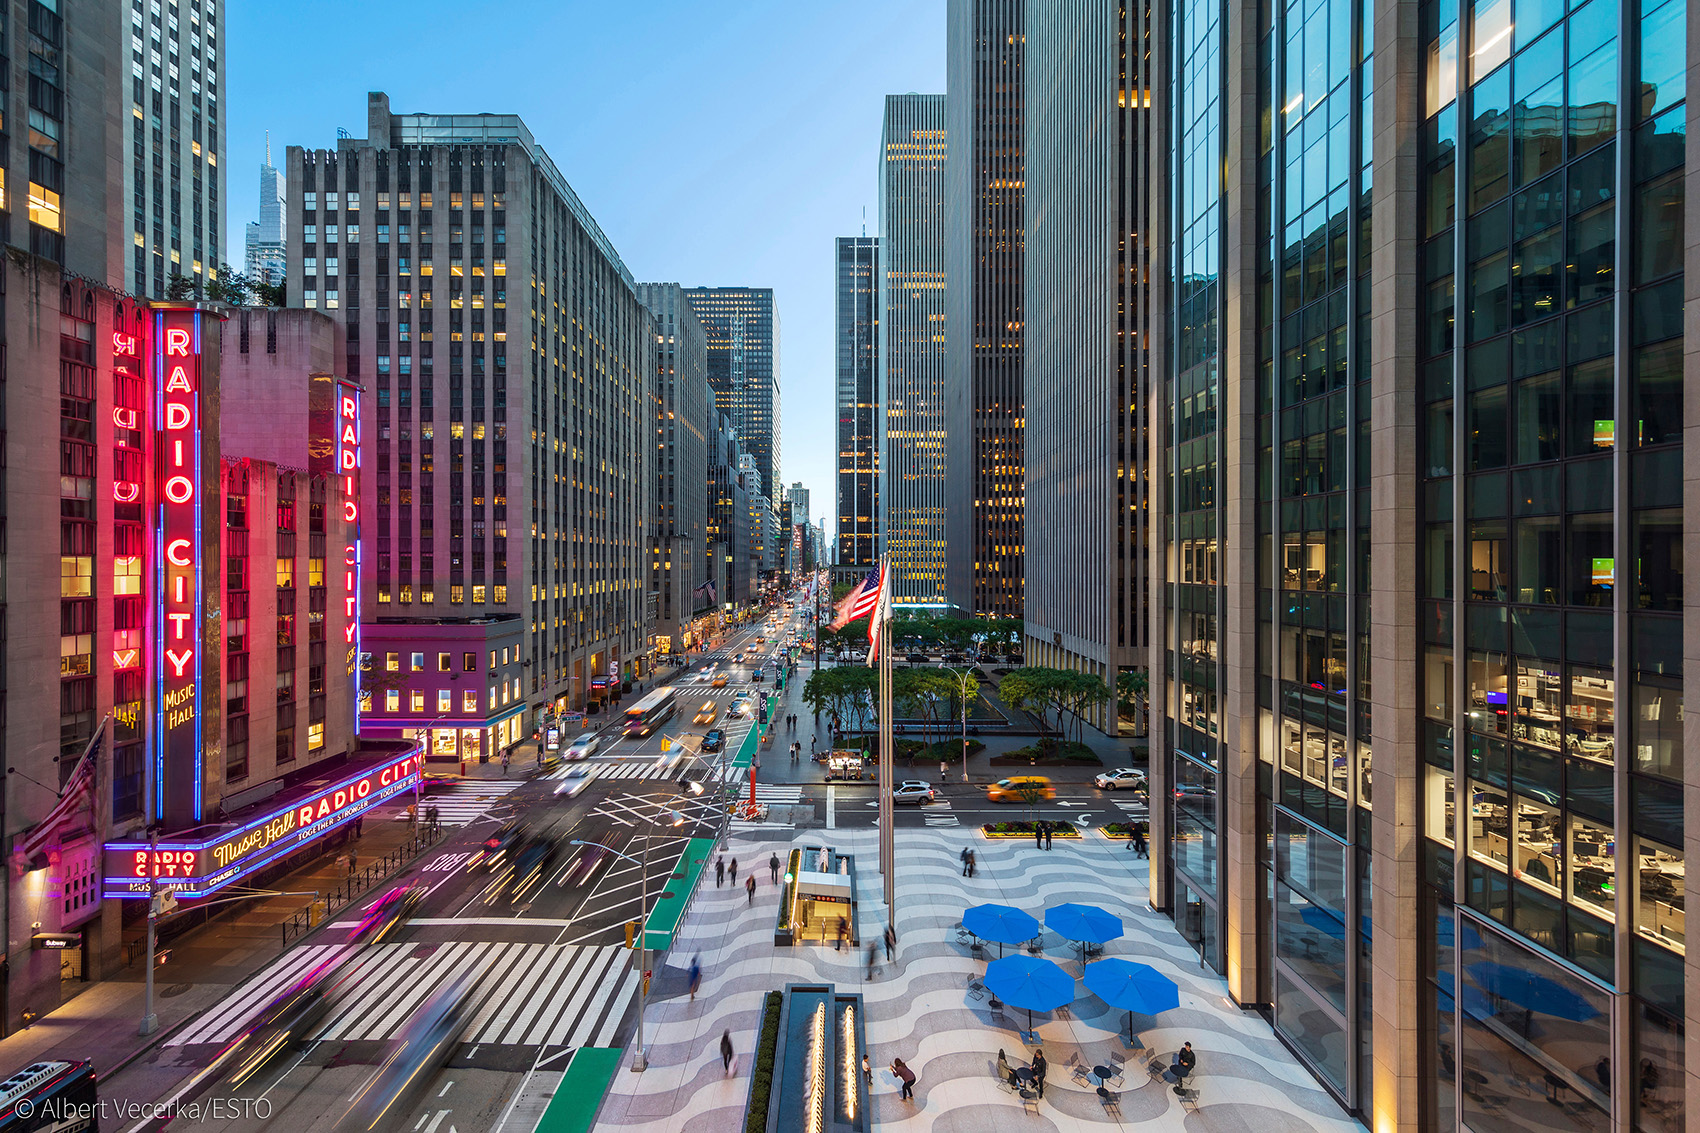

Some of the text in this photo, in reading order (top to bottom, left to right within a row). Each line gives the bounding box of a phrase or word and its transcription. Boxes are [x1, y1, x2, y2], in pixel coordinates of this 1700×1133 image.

[165, 328, 193, 503] RADIO
[166, 539, 192, 677] CITY
[165, 683, 195, 711] MUSIC
[169, 705, 195, 729] HALL
[380, 781, 407, 799] TOGETHER
[213, 829, 262, 868] Music
[258, 810, 296, 848] Hall
[299, 779, 370, 827] RADIO
[298, 801, 369, 841] TOGETHER STRONGER
[135, 864, 195, 877] CITY
[421, 852, 471, 872] BUS
[169, 883, 196, 892] HALL
[209, 869, 234, 886] CHASE
